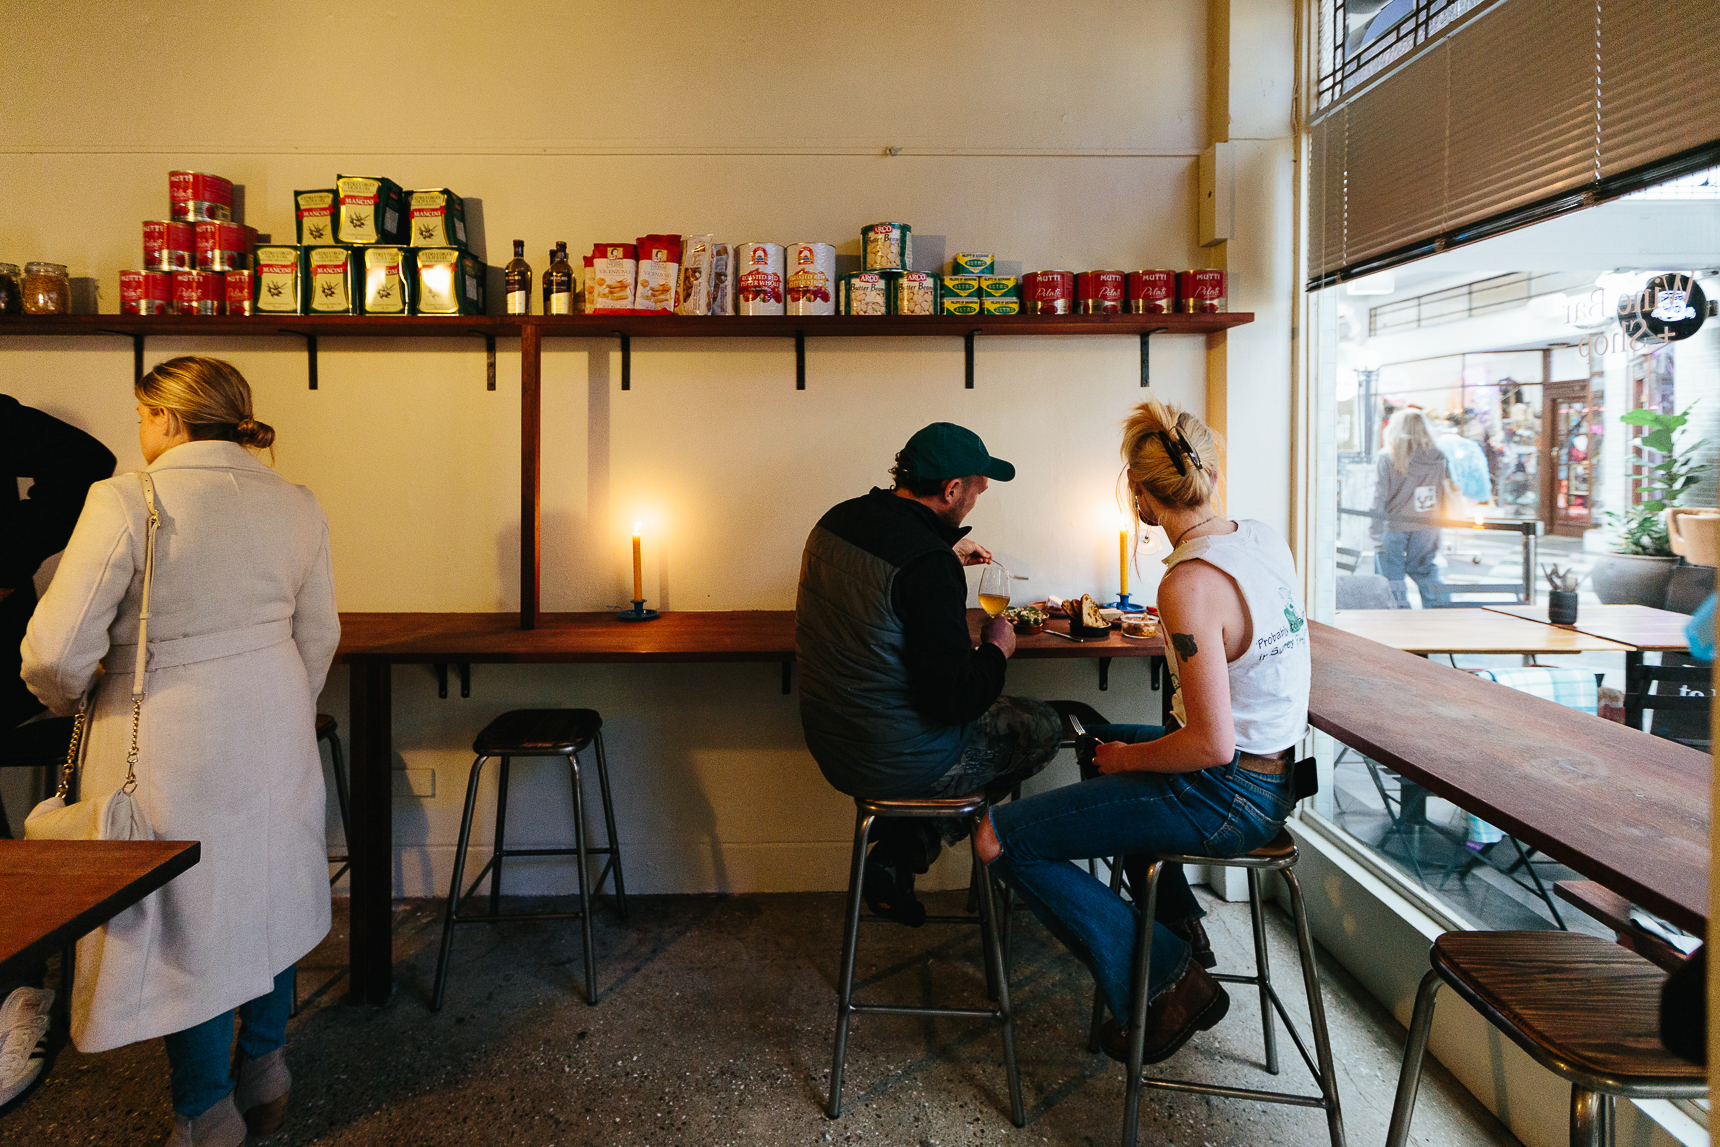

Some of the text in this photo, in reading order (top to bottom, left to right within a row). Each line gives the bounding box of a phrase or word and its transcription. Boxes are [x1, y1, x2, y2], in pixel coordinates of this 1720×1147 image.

[344, 197, 374, 205] MANCINI
[302, 210, 330, 218] MANCINI
[1036, 274, 1060, 282] MUTTI
[850, 283, 870, 292] Butter
[898, 282, 916, 291] Btter
[1035, 287, 1061, 298] Pelati
[1098, 286, 1121, 298] Pelati
[1141, 286, 1167, 298] Pelati
[1195, 286, 1220, 298] Pelati
